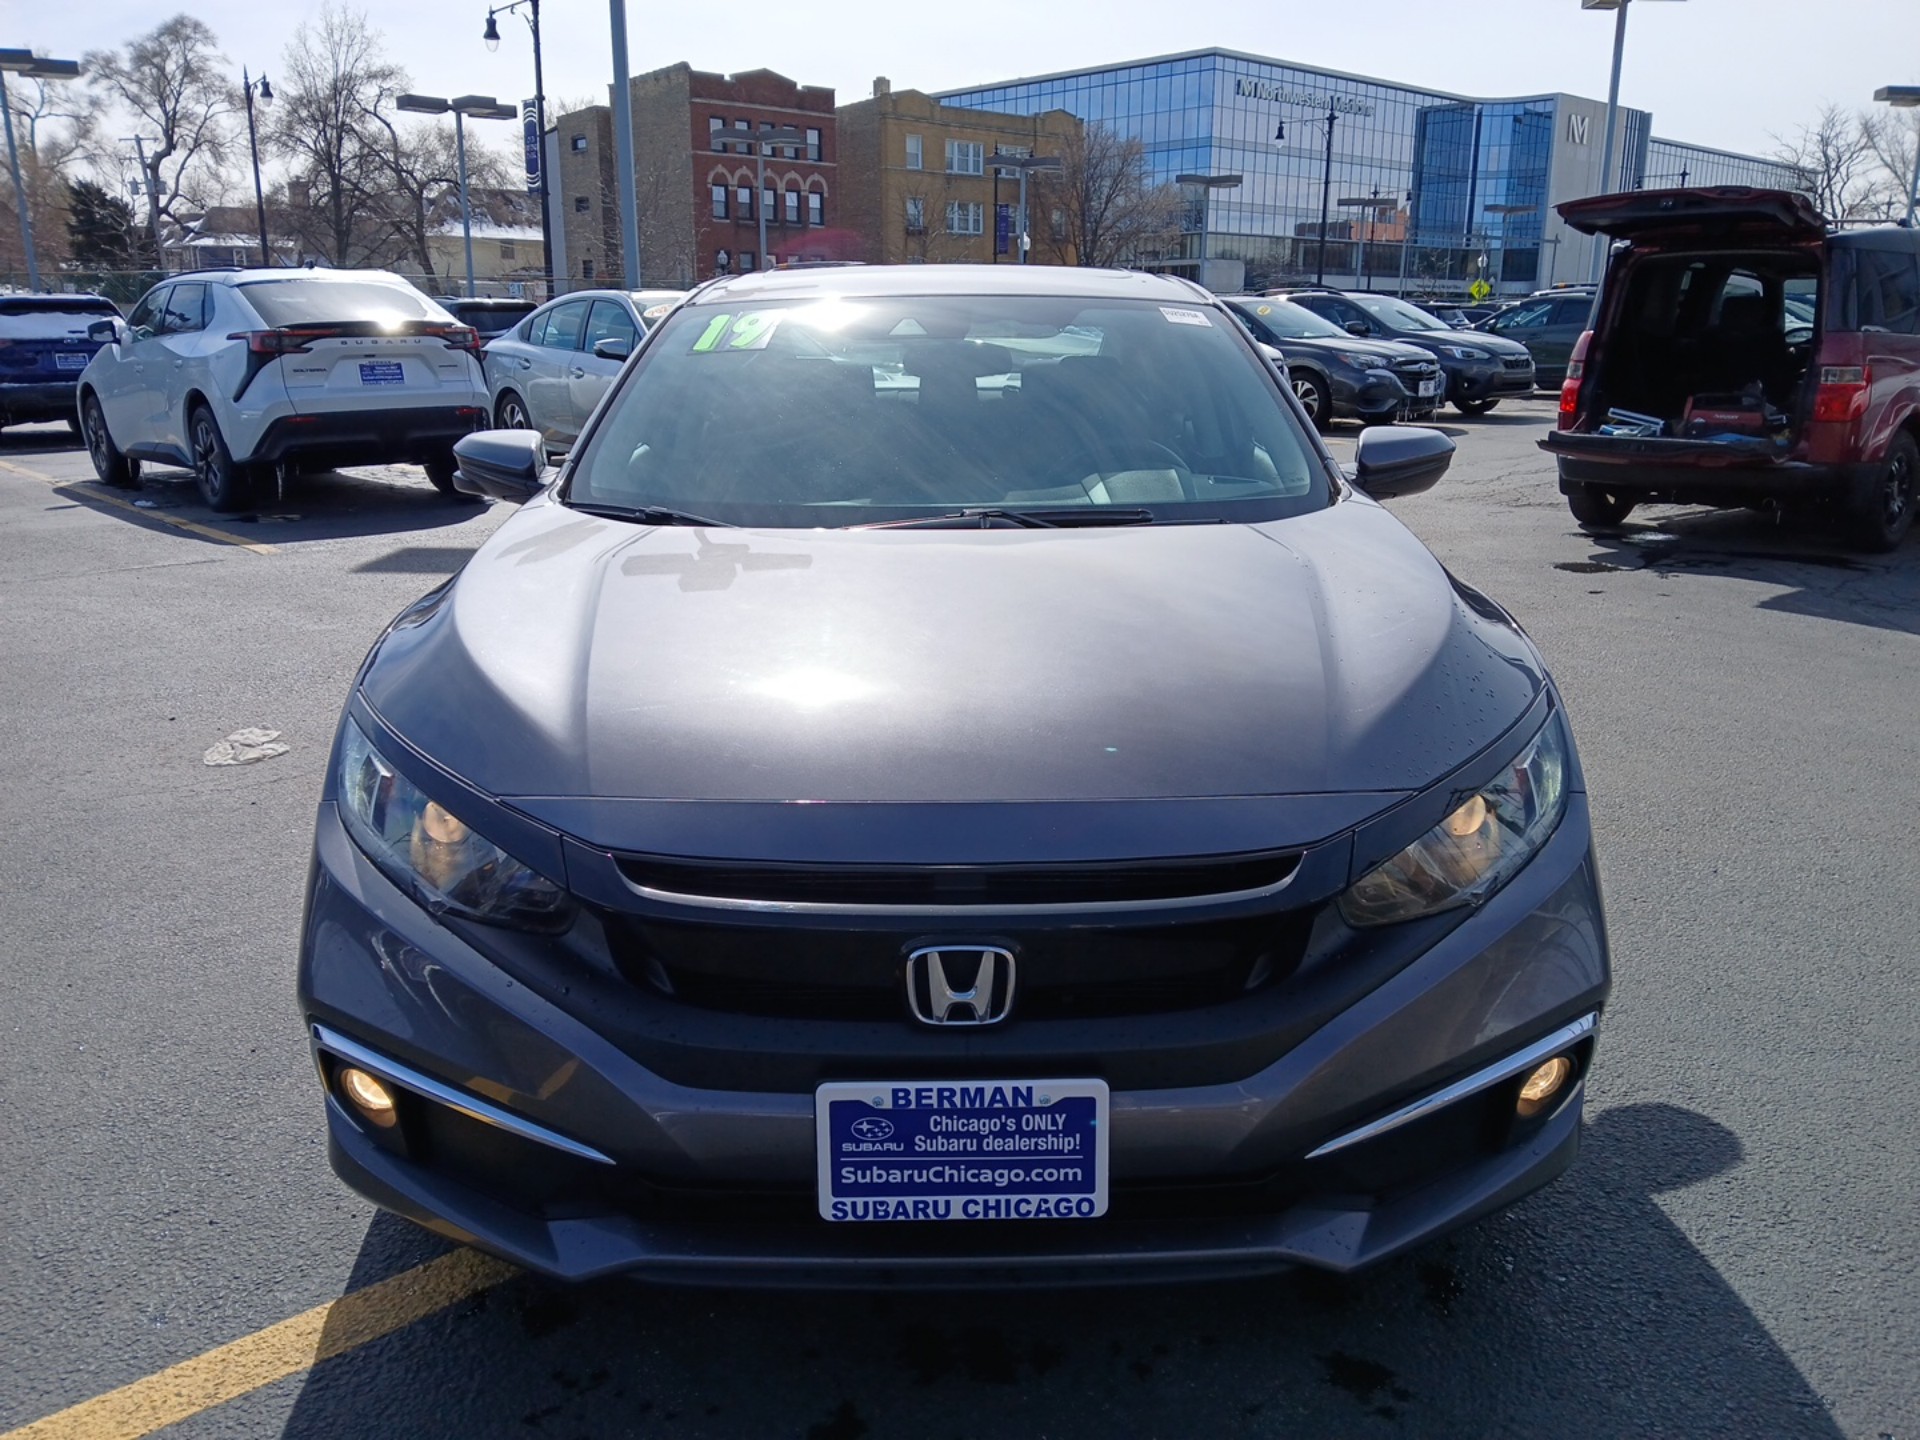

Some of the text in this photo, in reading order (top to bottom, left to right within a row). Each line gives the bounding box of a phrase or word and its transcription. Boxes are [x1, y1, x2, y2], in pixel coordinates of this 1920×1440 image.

[1257, 81, 1331, 110] Northwestern
[1334, 95, 1375, 117] Medicine
[340, 338, 421, 346] SUBARU
[692, 311, 775, 352] 19
[891, 1086, 1034, 1109] BERMAN
[929, 1114, 1067, 1133] Chicago's ONLY
[842, 1142, 904, 1152] SUBARU
[914, 1133, 1081, 1154] Subaru dealership!
[840, 1165, 1083, 1187] SubaruChicago.com
[831, 1196, 1096, 1221] SUBARU CHICAGO
